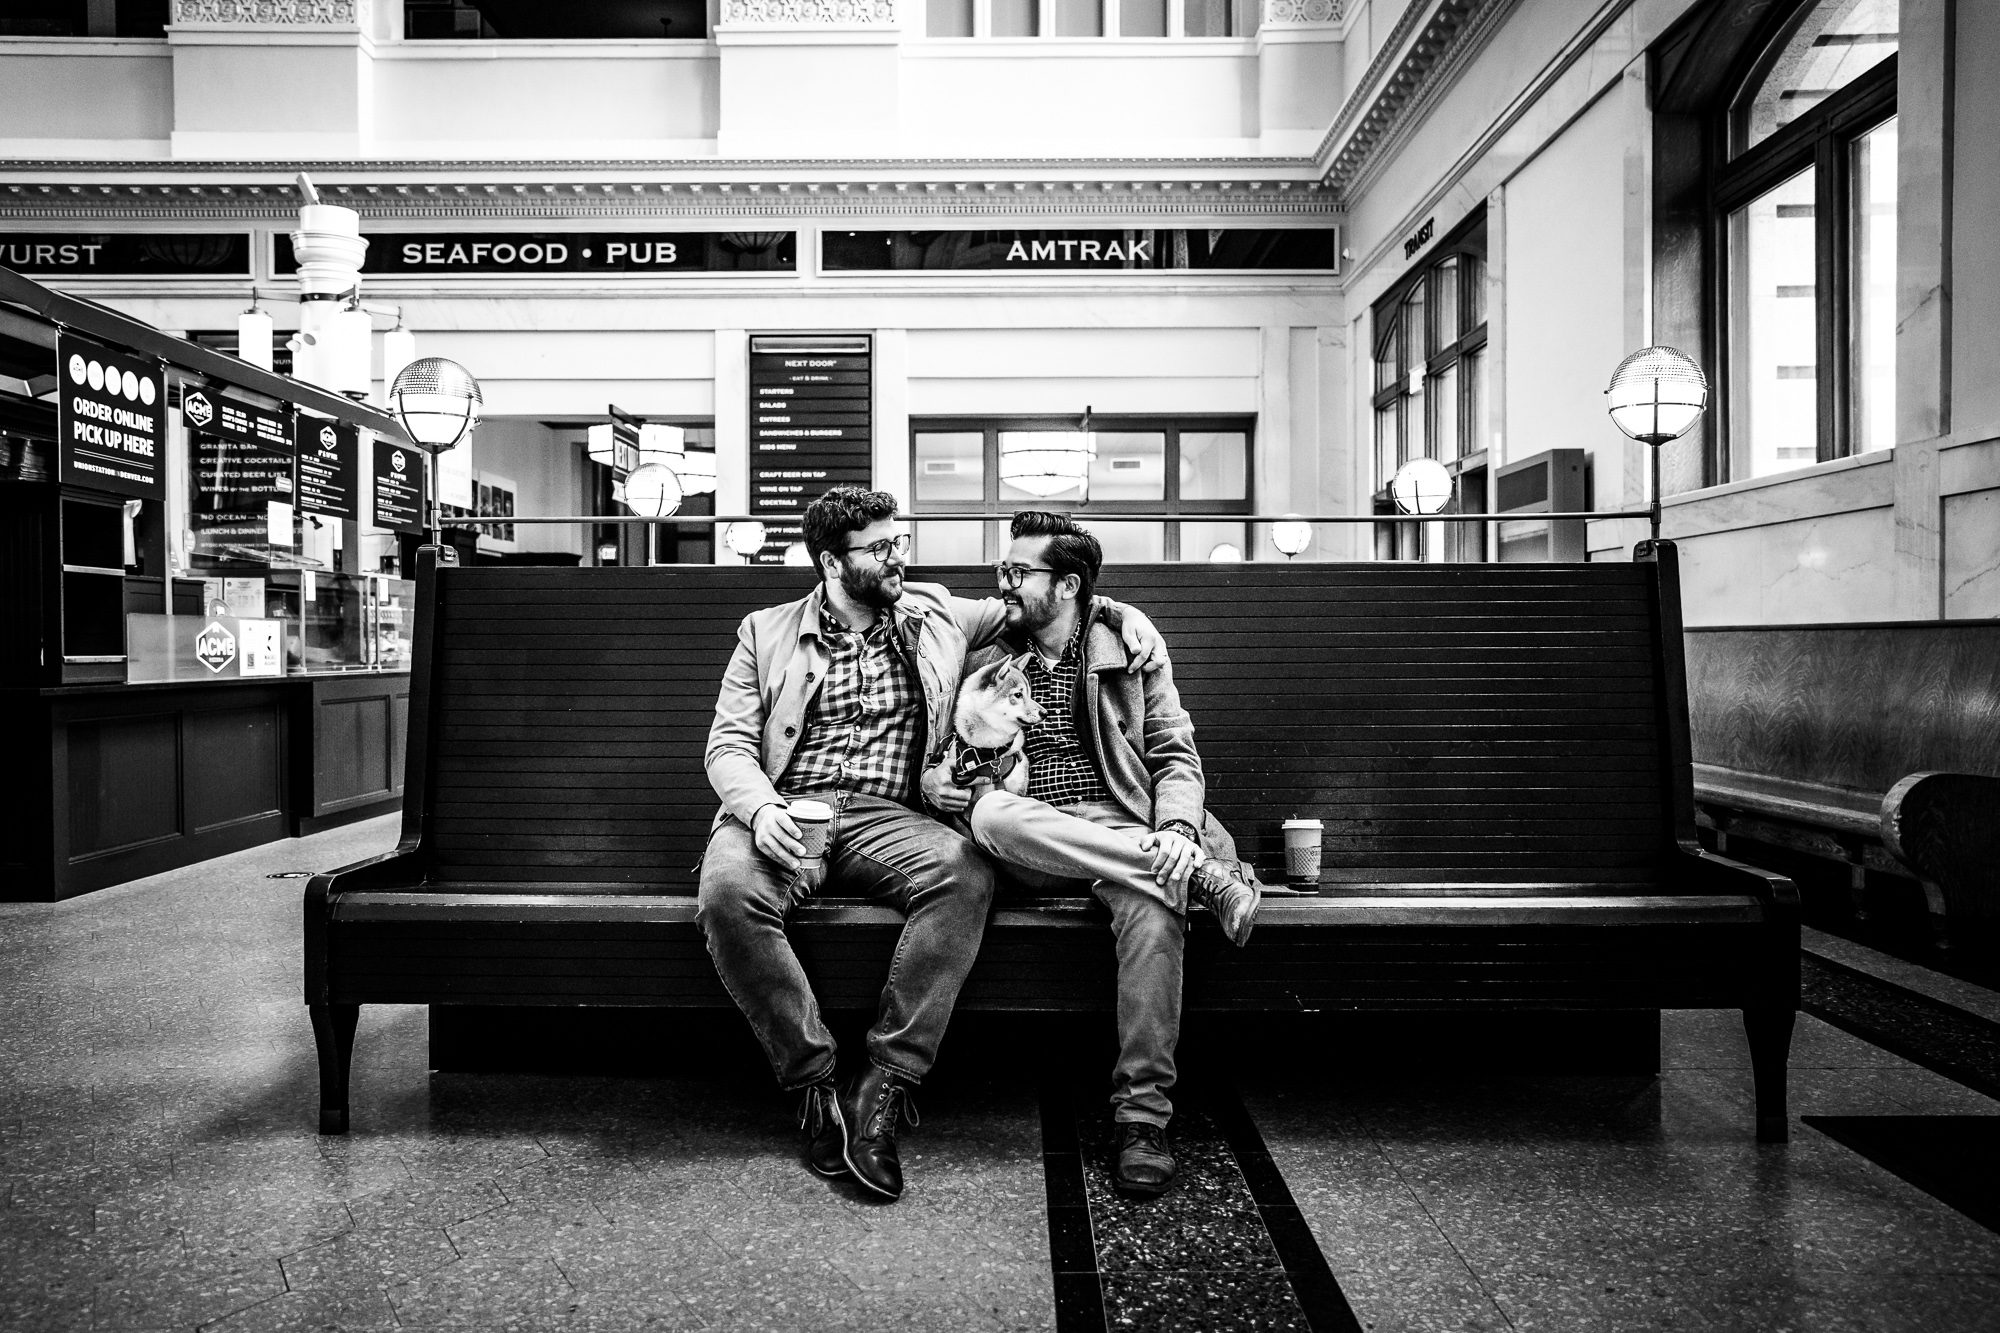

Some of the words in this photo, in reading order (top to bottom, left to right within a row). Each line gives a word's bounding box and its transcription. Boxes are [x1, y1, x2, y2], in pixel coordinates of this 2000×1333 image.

[1404, 217, 1435, 260] TRANSIT
[0, 244, 102, 265] URST
[402, 243, 568, 264] SEAFOOD
[606, 243, 677, 263] PUB
[1006, 240, 1150, 261] AMTRAK
[73, 396, 112, 422] ORDER
[113, 408, 154, 433] ONLINE
[74, 420, 103, 445] PICK
[104, 429, 122, 448] UP
[123, 433, 154, 457] HERE
[199, 637, 234, 656] ACME
